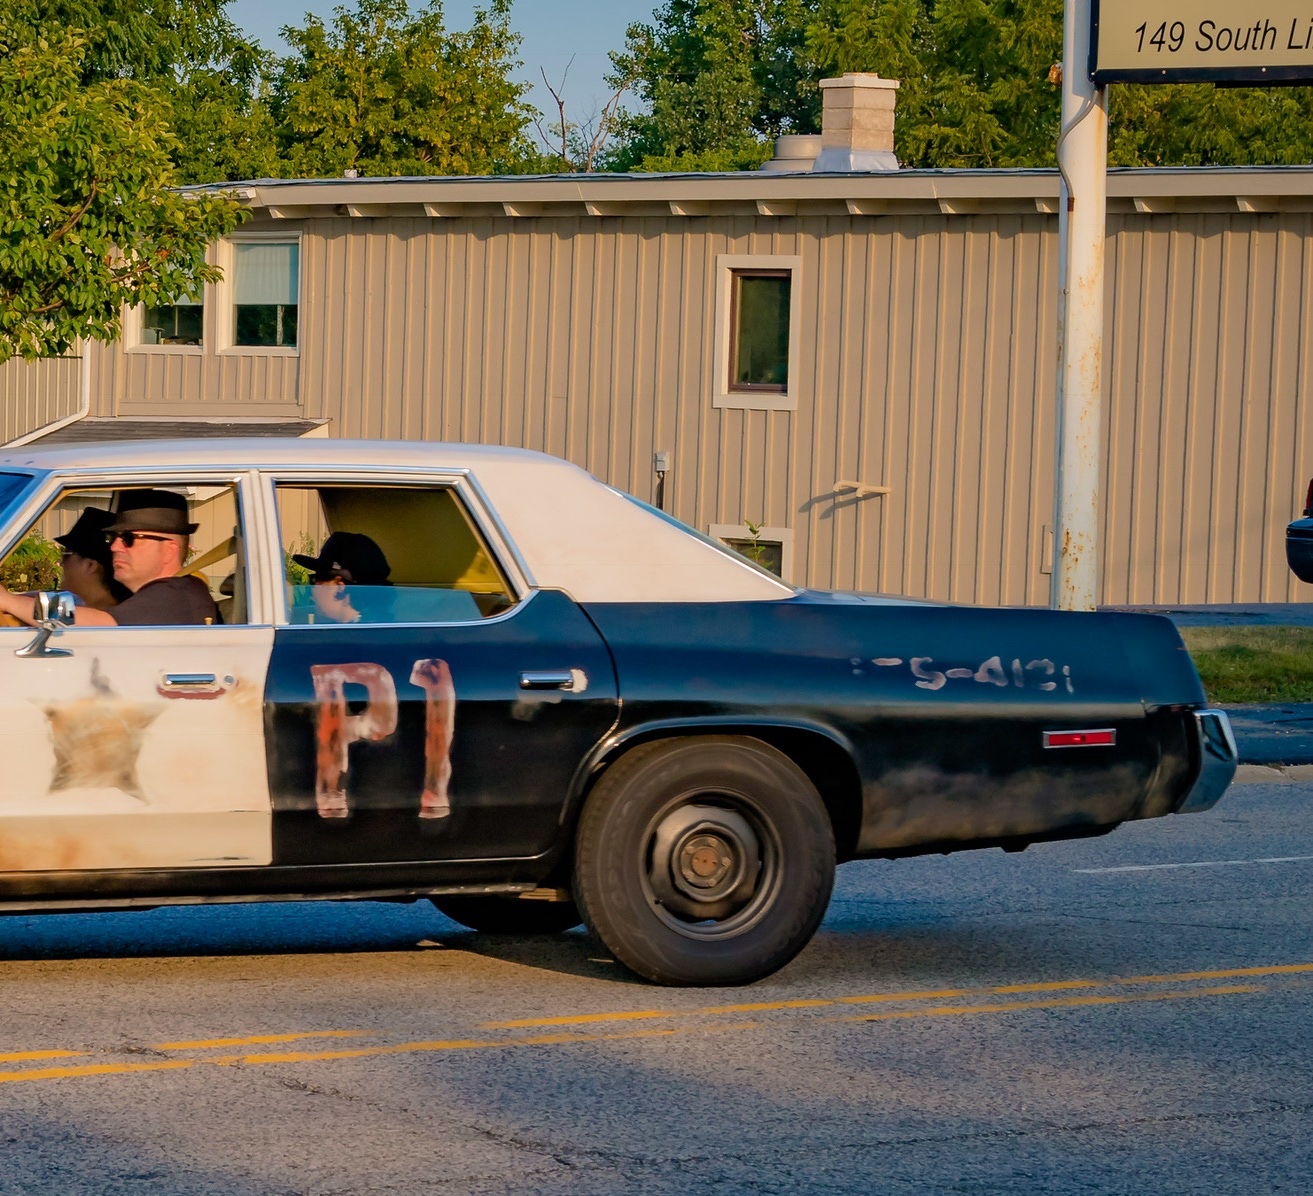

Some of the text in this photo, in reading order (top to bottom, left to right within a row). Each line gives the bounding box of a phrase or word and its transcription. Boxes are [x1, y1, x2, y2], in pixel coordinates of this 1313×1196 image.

[1135, 21, 1185, 52] 149
[1195, 19, 1277, 51] South
[311, 658, 455, 819] P1
